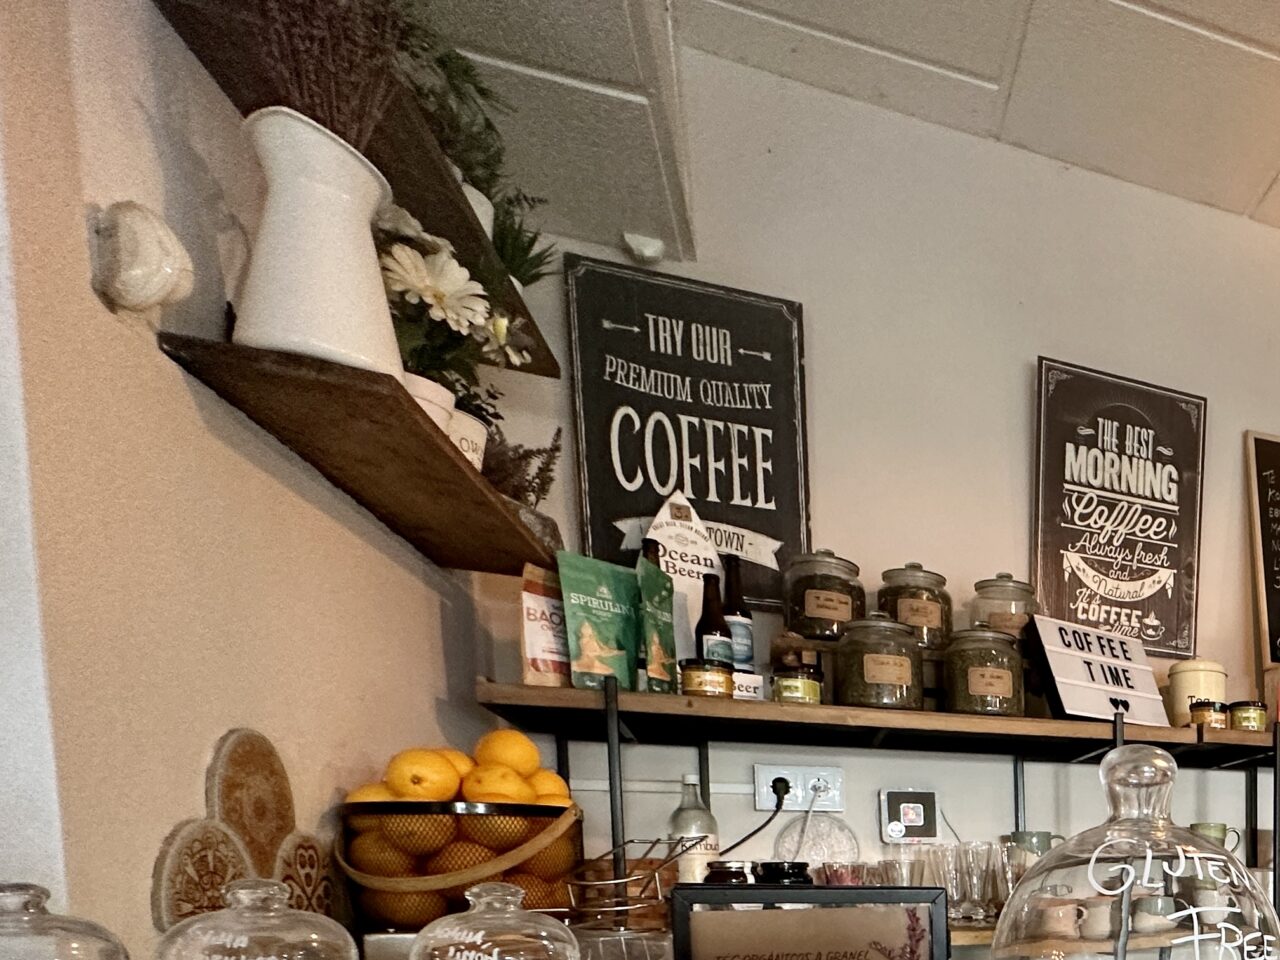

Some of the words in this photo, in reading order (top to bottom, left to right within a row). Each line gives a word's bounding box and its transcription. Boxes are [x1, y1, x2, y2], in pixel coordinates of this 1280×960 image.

[644, 313, 683, 357] TRY
[691, 322, 732, 366] OUR
[603, 354, 693, 403] PREMIUM
[700, 378, 772, 410] QUALITY
[610, 405, 776, 511] COFFEE
[1097, 417, 1118, 452] THE
[1125, 424, 1155, 461] BEST
[1064, 442, 1179, 504] MORNING
[706, 527, 745, 552] TOWN
[1072, 491, 1167, 546] Coffee
[1069, 532, 1131, 569] Always
[1132, 542, 1171, 570] fresh
[1093, 575, 1146, 600] Natural
[1109, 567, 1130, 581] and
[1077, 601, 1142, 627] COFFEE
[1058, 627, 1132, 662] COFFEE
[1088, 838, 1254, 896] GLUTEN
